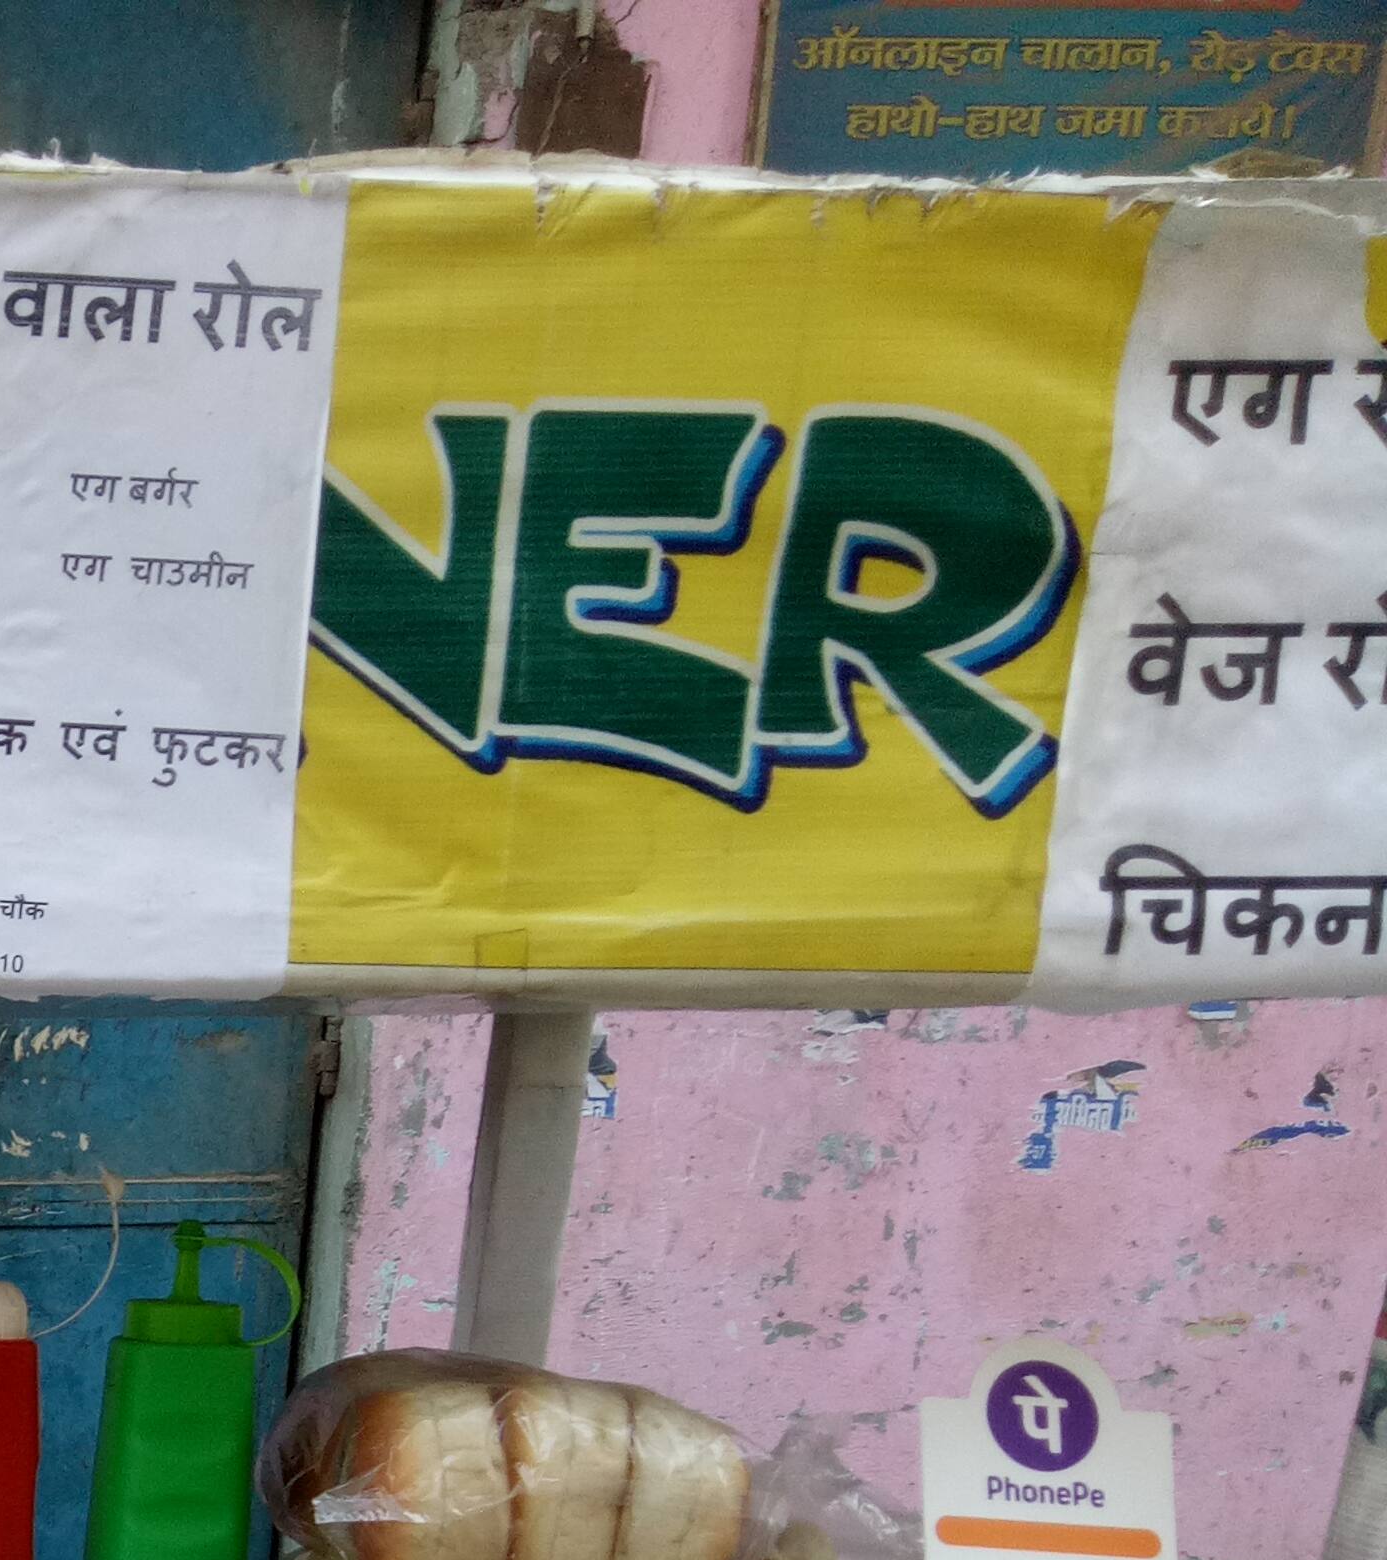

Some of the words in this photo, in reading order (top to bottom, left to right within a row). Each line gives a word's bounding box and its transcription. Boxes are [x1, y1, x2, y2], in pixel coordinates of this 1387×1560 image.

[793, 25, 1009, 76] ऑनलाइन
[1021, 36, 1171, 75] चालान,
[1055, 104, 1148, 139] जमा
[3, 270, 177, 344] वाला
[192, 259, 323, 352] रोल
[1168, 357, 1335, 445] एग
[70, 473, 123, 503] एग
[129, 467, 200, 506] बर्गर
[61, 553, 113, 582] एग
[130, 550, 255, 589] चाउमीन
[1127, 592, 1306, 706] वेज
[60, 709, 127, 762] एवं
[151, 727, 286, 788] फुटकर
[1099, 843, 1387, 956] चिकन
[1013, 1375, 1068, 1454] पे
[987, 1475, 1105, 1508] PhonePe
